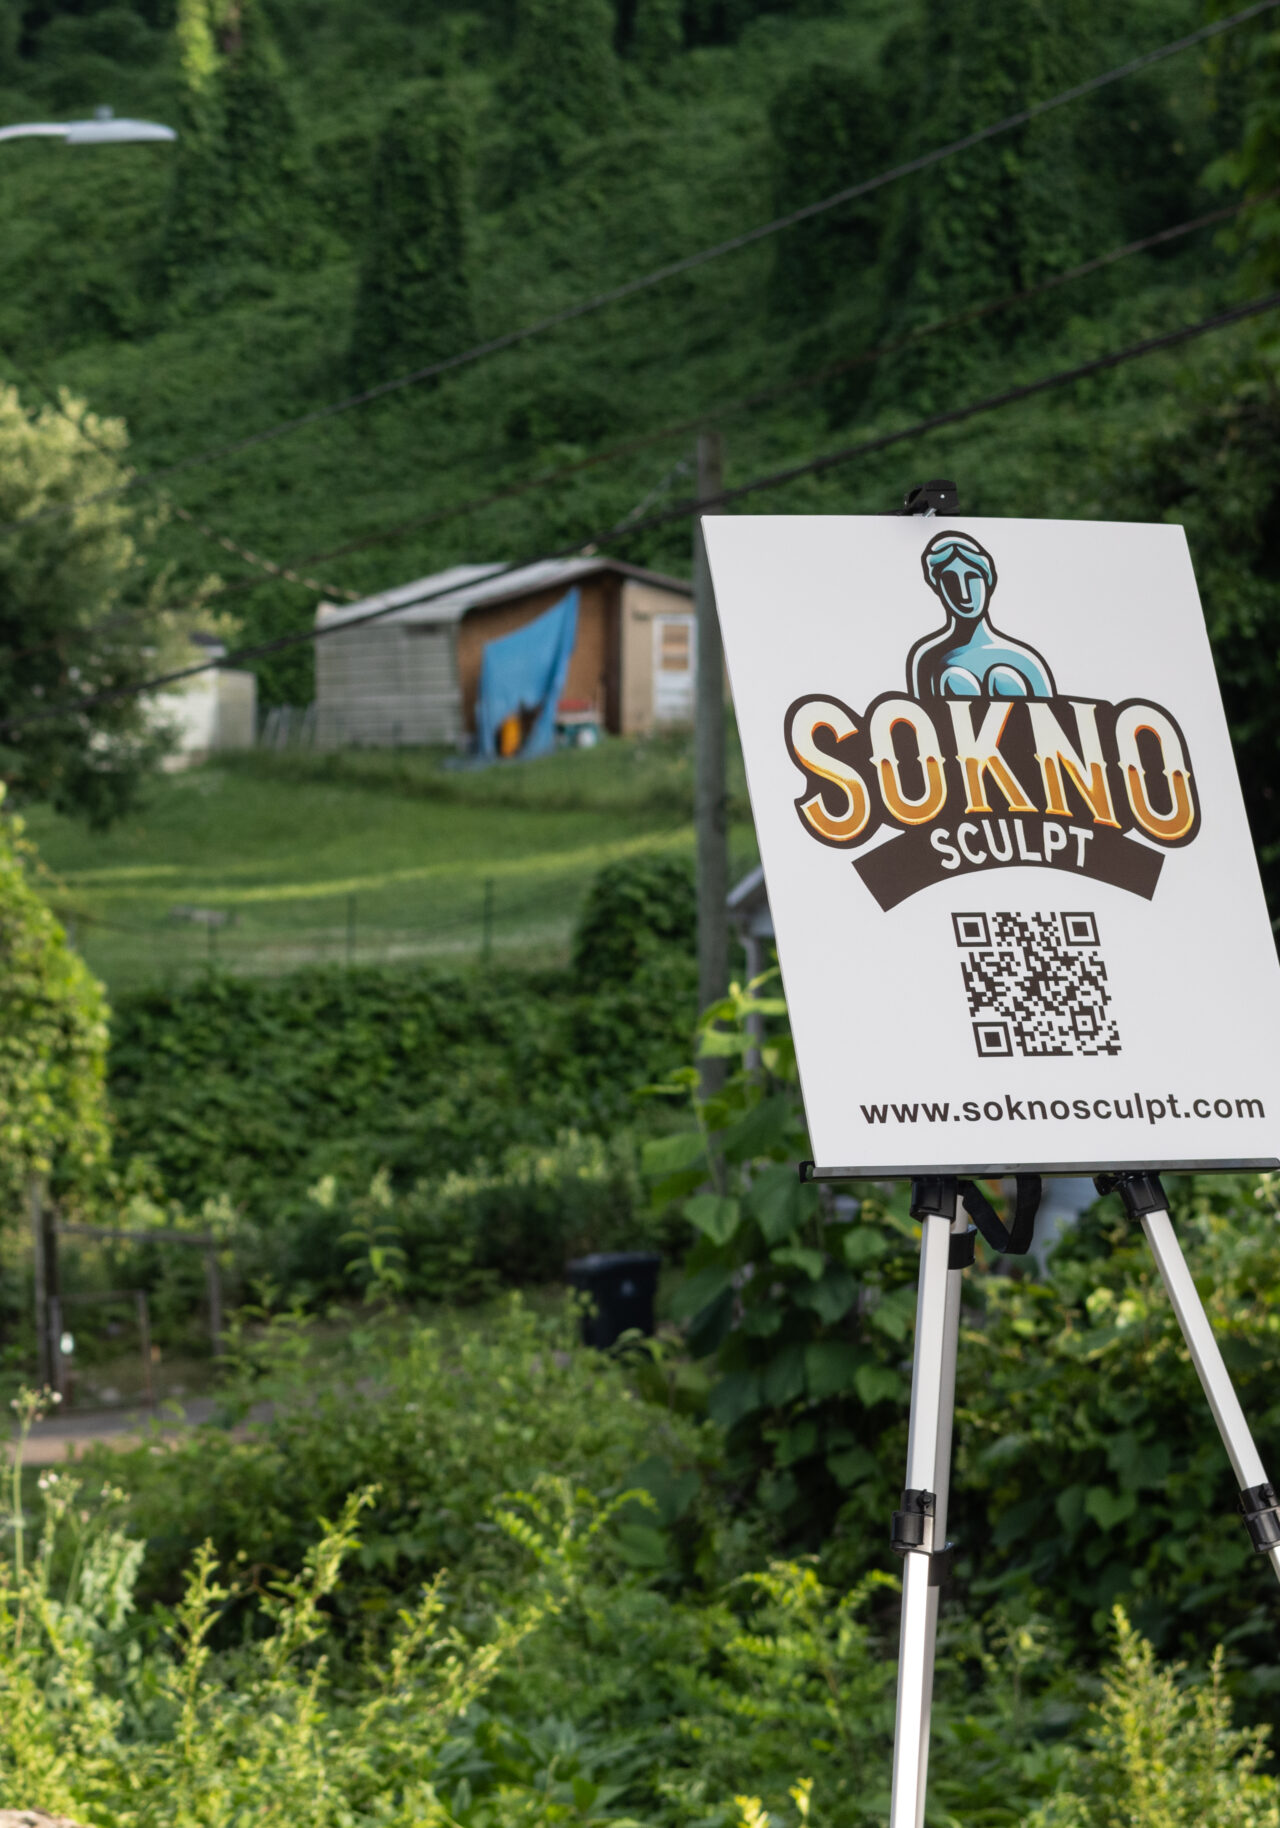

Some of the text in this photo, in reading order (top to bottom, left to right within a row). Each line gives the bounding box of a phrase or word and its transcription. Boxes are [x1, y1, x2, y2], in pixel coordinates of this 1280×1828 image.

[790, 698, 1196, 842] SOKNO
[930, 818, 1094, 870] SCULPT
[859, 1092, 1266, 1125] www.soknosculpt.com
